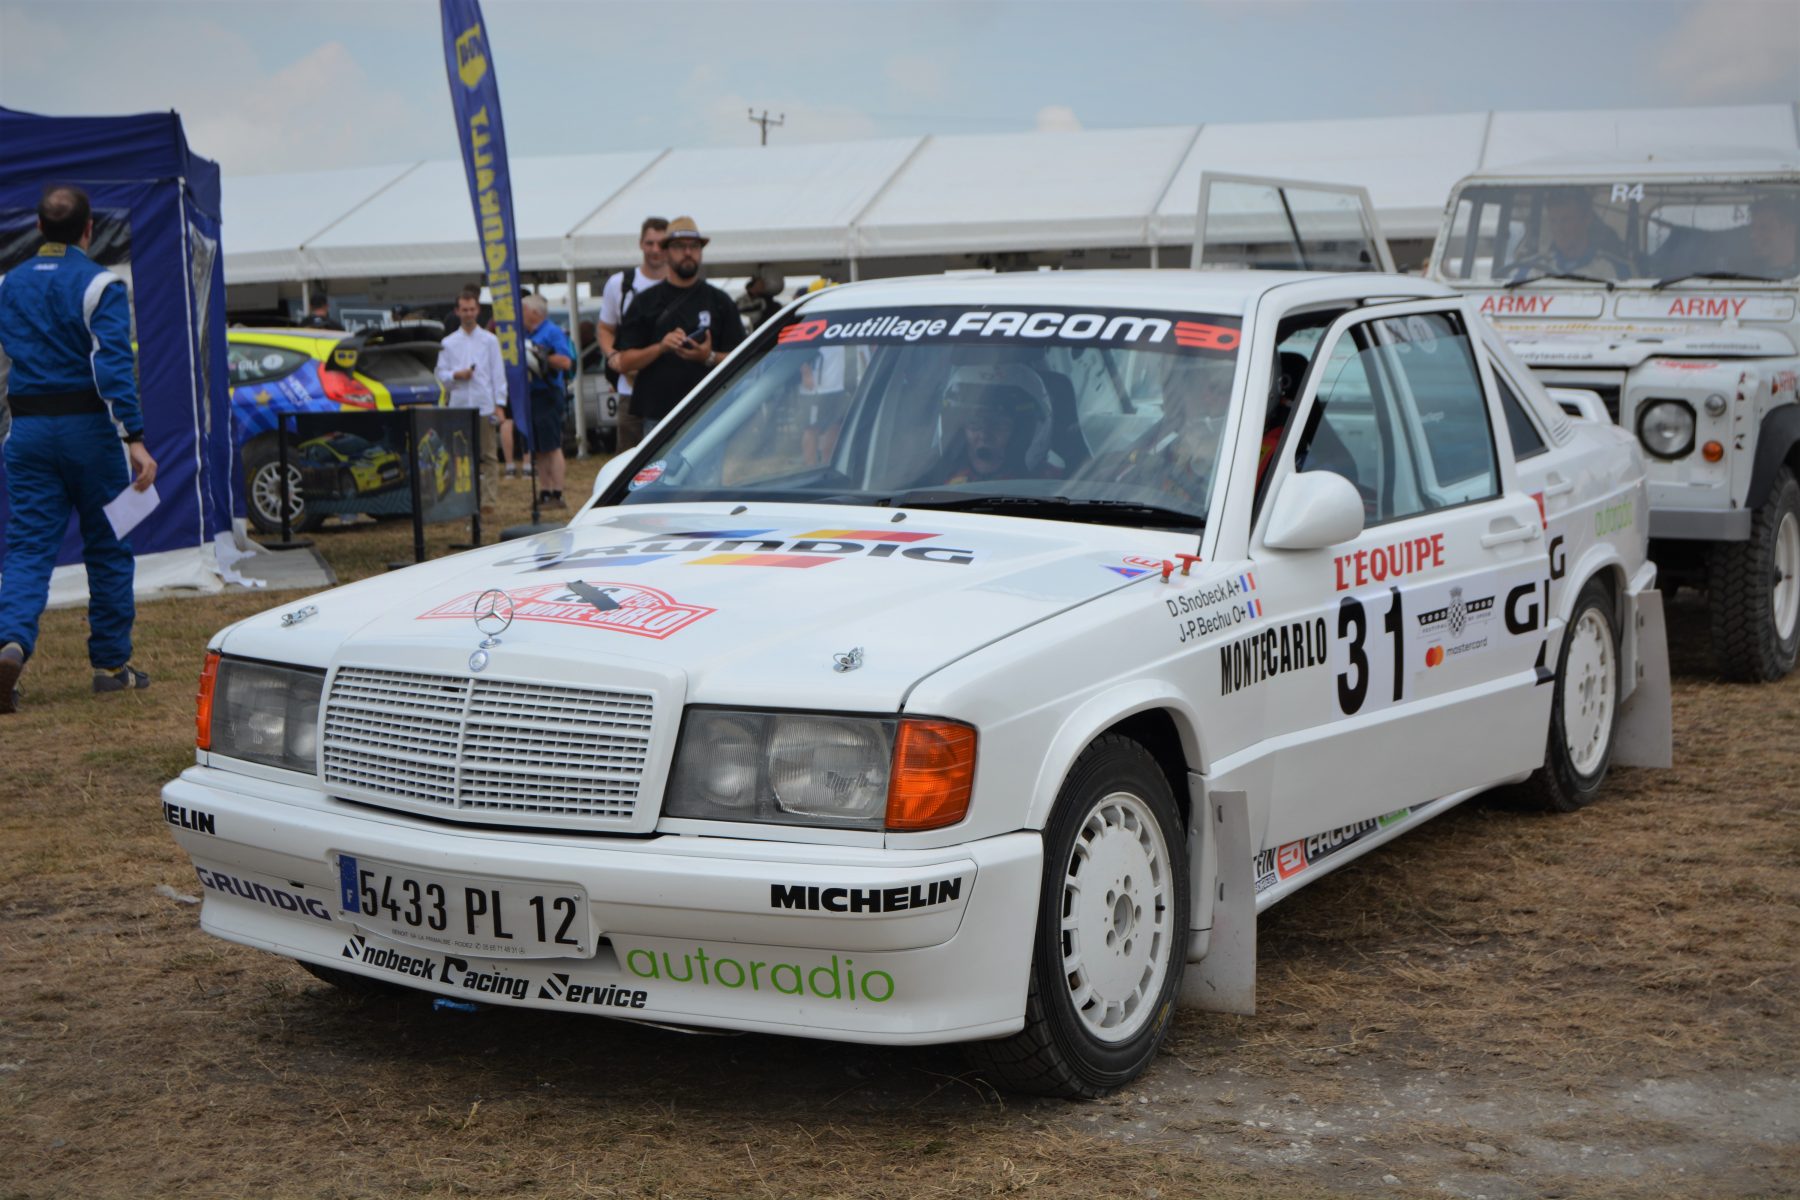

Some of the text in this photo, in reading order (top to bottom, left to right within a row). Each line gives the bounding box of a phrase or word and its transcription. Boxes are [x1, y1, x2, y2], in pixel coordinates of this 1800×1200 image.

[1610, 184, 1645, 203] R4
[1480, 295, 1554, 314] ARMY
[1668, 298, 1748, 318] ARMY
[824, 311, 1172, 343] outillage FACOM
[1338, 586, 1404, 716] 31
[196, 866, 333, 921] GRUNDIG
[360, 870, 578, 945] 5433 PL 12
[771, 877, 962, 913] MICHELIN
[626, 947, 895, 1003] autoradio
